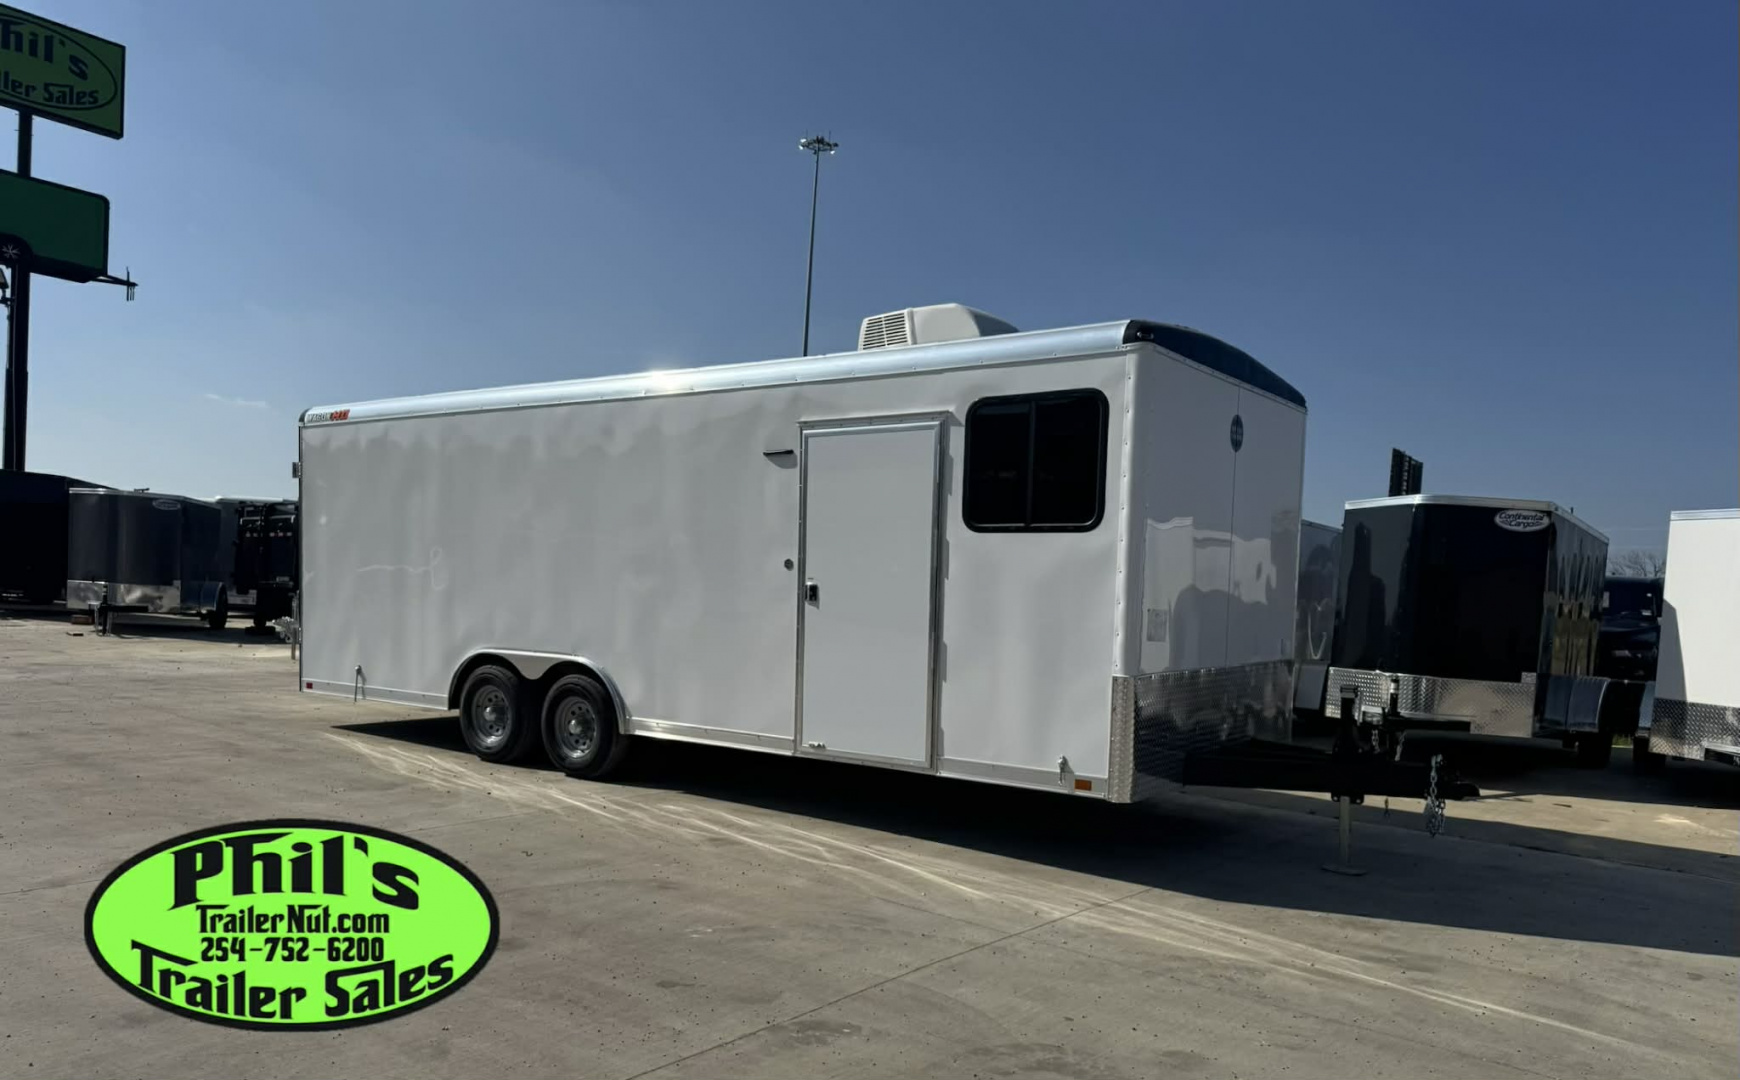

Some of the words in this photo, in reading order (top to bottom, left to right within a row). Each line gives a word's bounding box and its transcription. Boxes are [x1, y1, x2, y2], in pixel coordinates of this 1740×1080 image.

[0, 18, 89, 81] hil's
[0, 70, 37, 98] ler
[43, 82, 99, 105] Sales
[1499, 511, 1546, 522] Continental
[1509, 520, 1535, 529] Cargo
